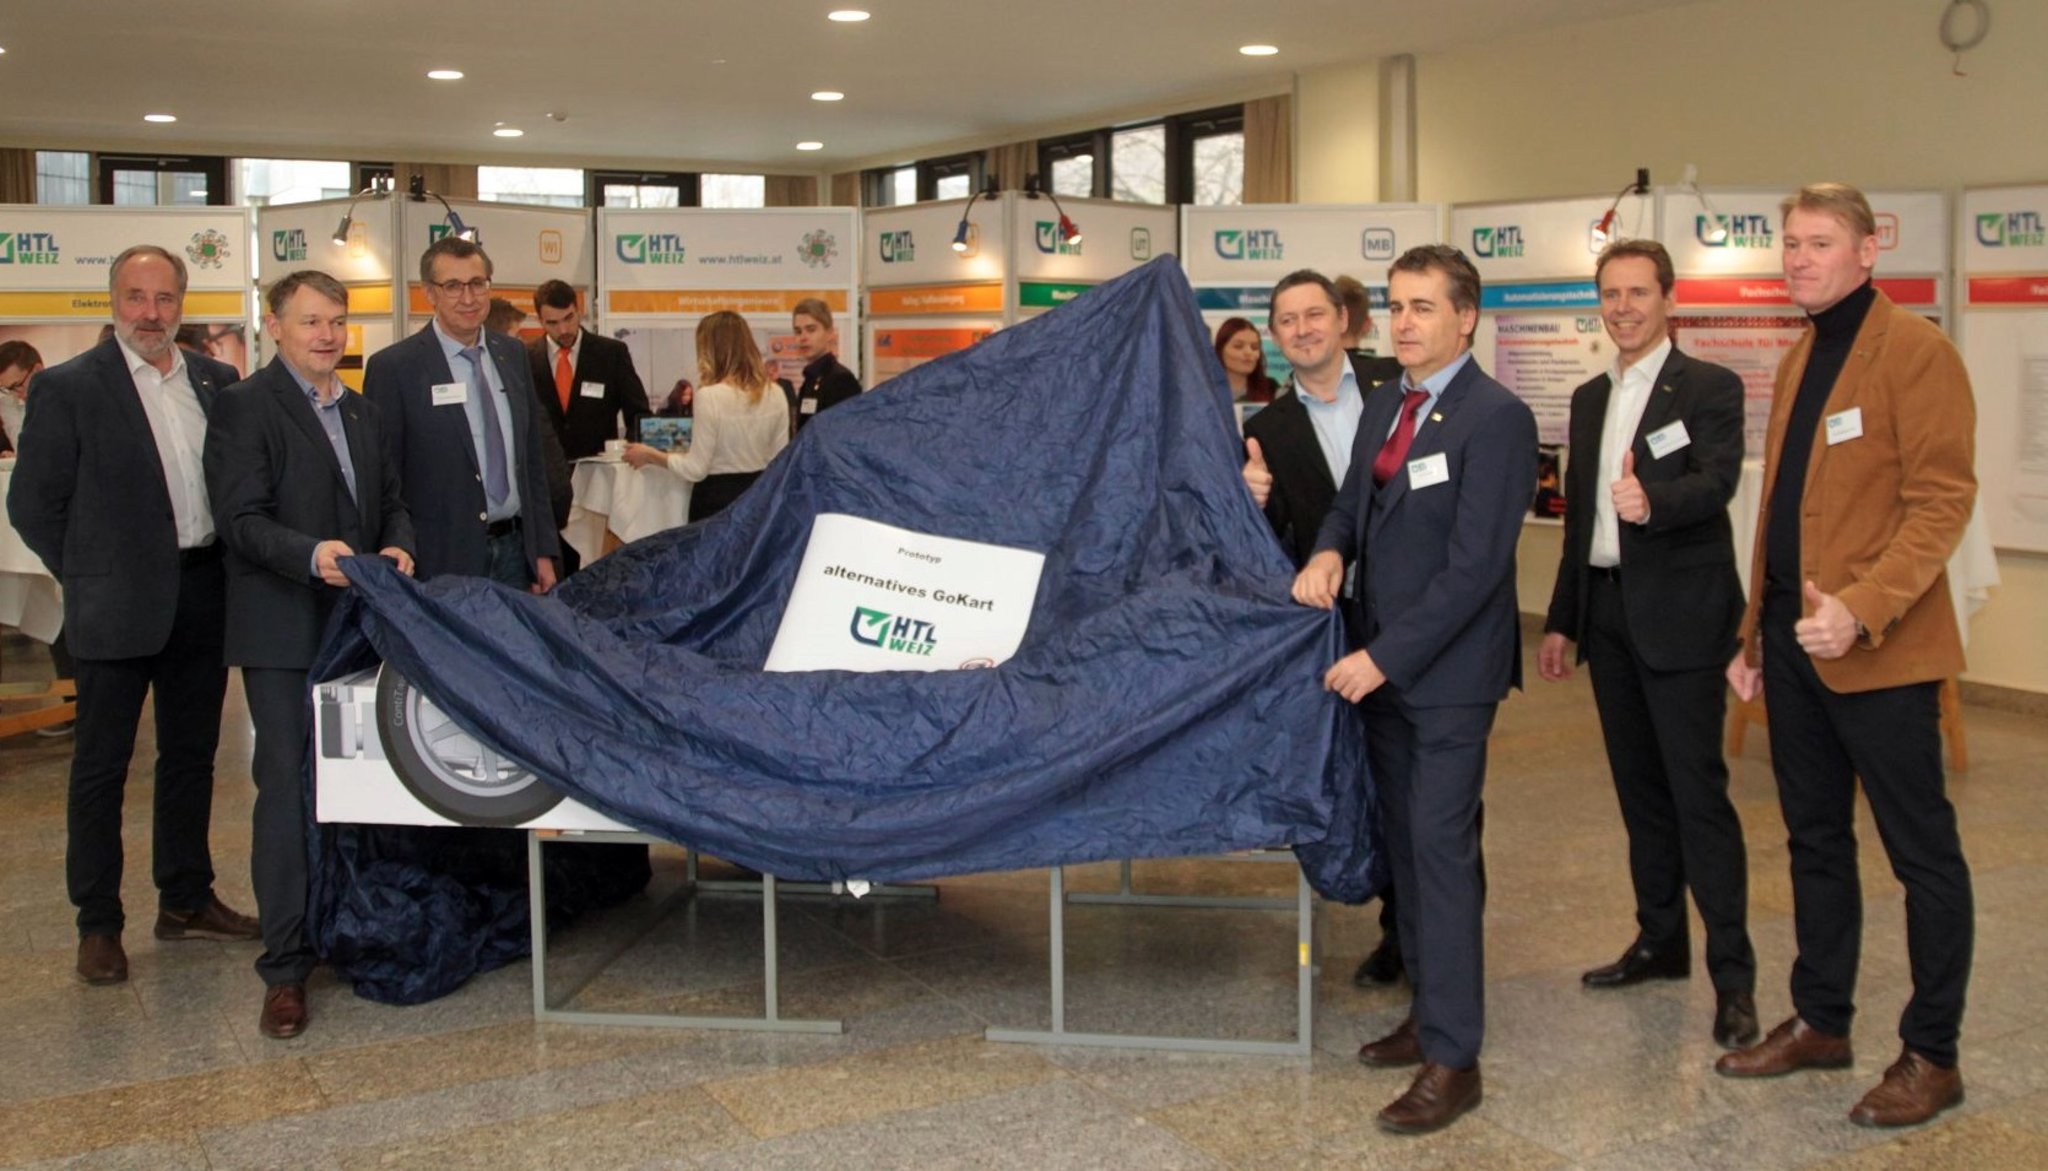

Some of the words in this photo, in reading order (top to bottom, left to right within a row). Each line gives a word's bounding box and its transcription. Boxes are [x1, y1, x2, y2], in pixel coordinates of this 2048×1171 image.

[1733, 215, 1772, 234] HTL
[2009, 213, 2044, 232] HTL
[17, 233, 59, 251] HTL
[289, 229, 306, 247] HTL
[649, 234, 685, 251] HTL
[895, 231, 914, 248] HTL
[1247, 230, 1283, 248] HTL
[1497, 226, 1524, 245] HTL
[1735, 235, 1772, 248] WEIZ
[2010, 233, 2045, 246] WEIZ
[1367, 239, 1391, 250] MB
[1498, 245, 1524, 257] WEIZ
[20, 252, 59, 264] WEIZ
[650, 252, 685, 264] WEIZ
[698, 255, 782, 264] www.htlweiz.at
[1248, 248, 1283, 260] WEIZ
[1497, 324, 1560, 333] MASCHINENBAU
[897, 547, 942, 564] Prototyp
[824, 565, 927, 598] alternatives
[933, 589, 994, 611] GoKart
[892, 616, 937, 644] HTL
[889, 638, 935, 656] WEIZ
